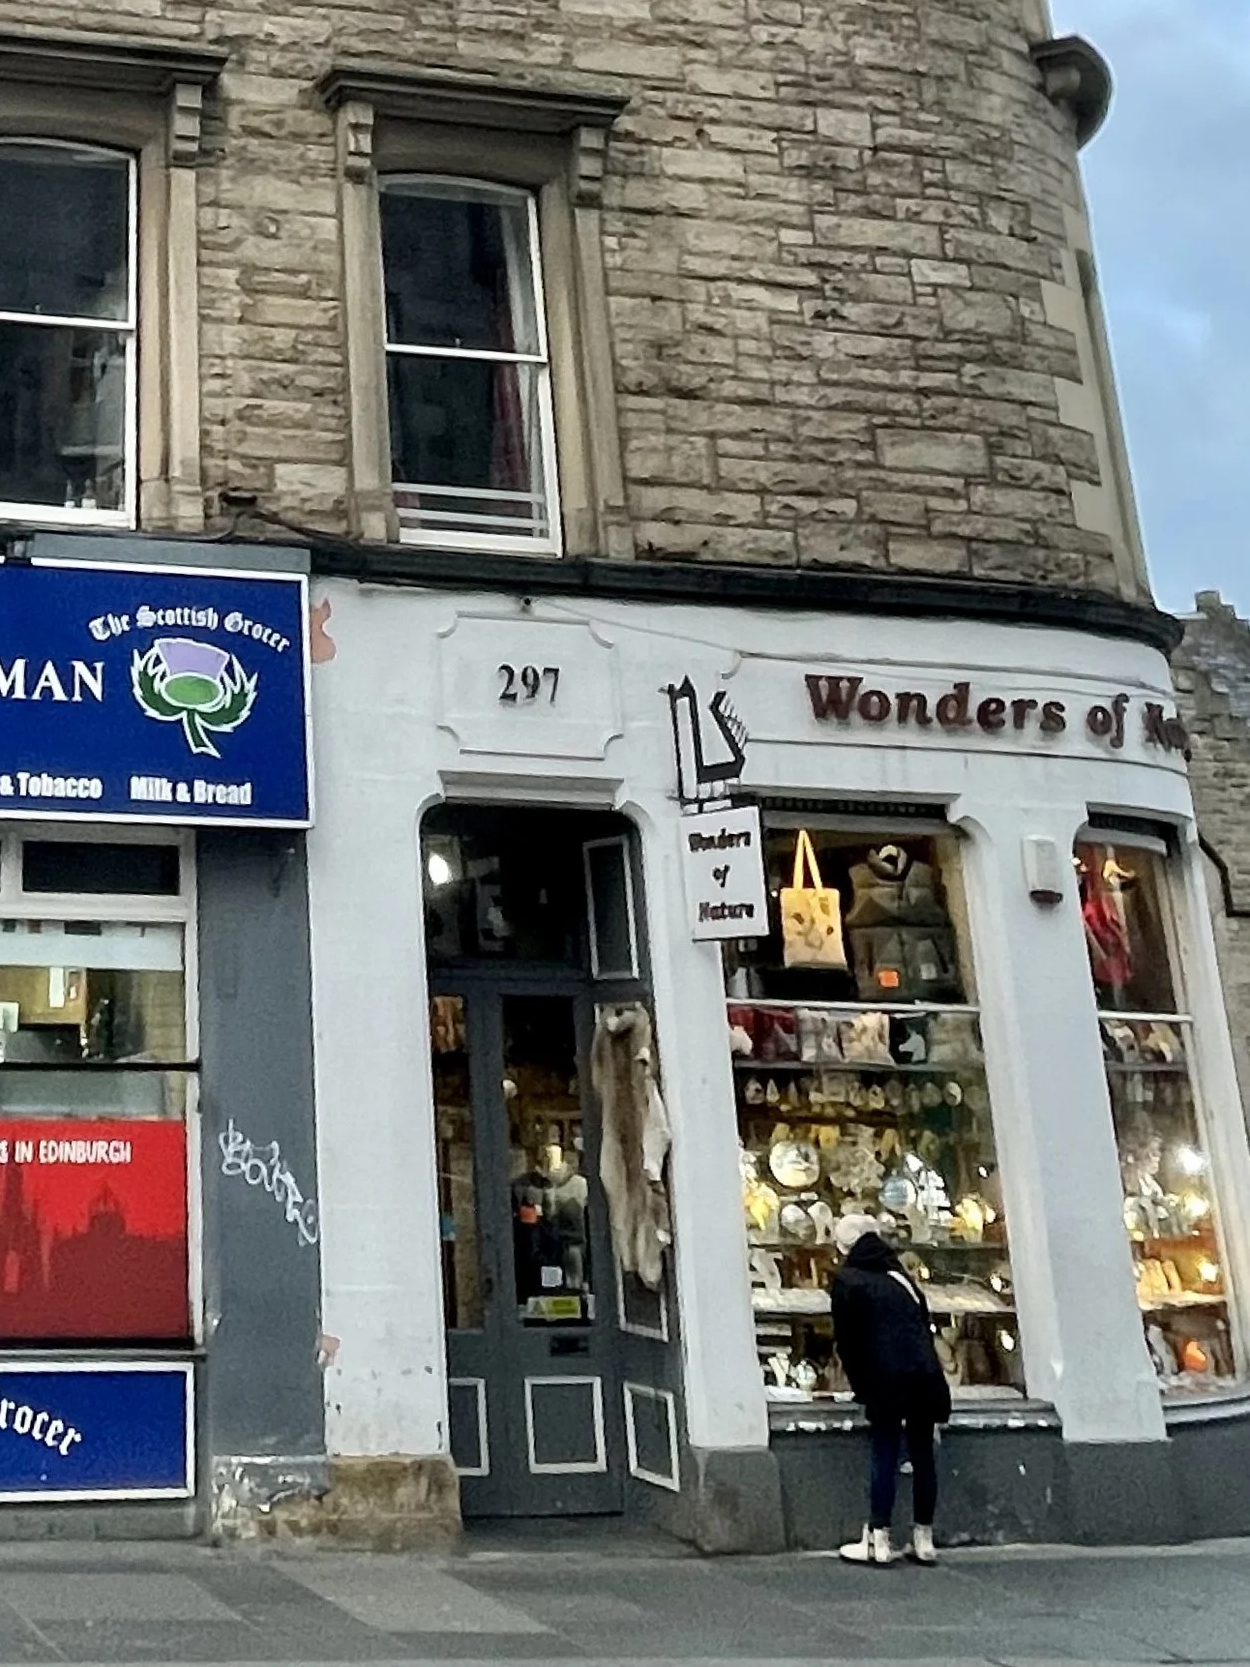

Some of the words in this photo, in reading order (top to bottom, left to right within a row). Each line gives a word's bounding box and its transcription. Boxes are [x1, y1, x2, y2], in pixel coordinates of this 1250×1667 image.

[88, 613, 131, 641] The
[136, 605, 219, 631] Scottish
[224, 611, 291, 653] Grocer
[498, 663, 560, 704] 297
[804, 673, 1066, 733] Wonders
[1086, 692, 1130, 750] of
[0, 774, 14, 797] &
[16, 771, 102, 800] Tobacco
[130, 775, 173, 802] Milk
[176, 781, 191, 803] &
[193, 779, 252, 806] Bread
[712, 864, 731, 888] of
[698, 902, 755, 923] Nature
[14, 1140, 34, 1163] IN
[39, 1139, 132, 1164] EDINBURGH
